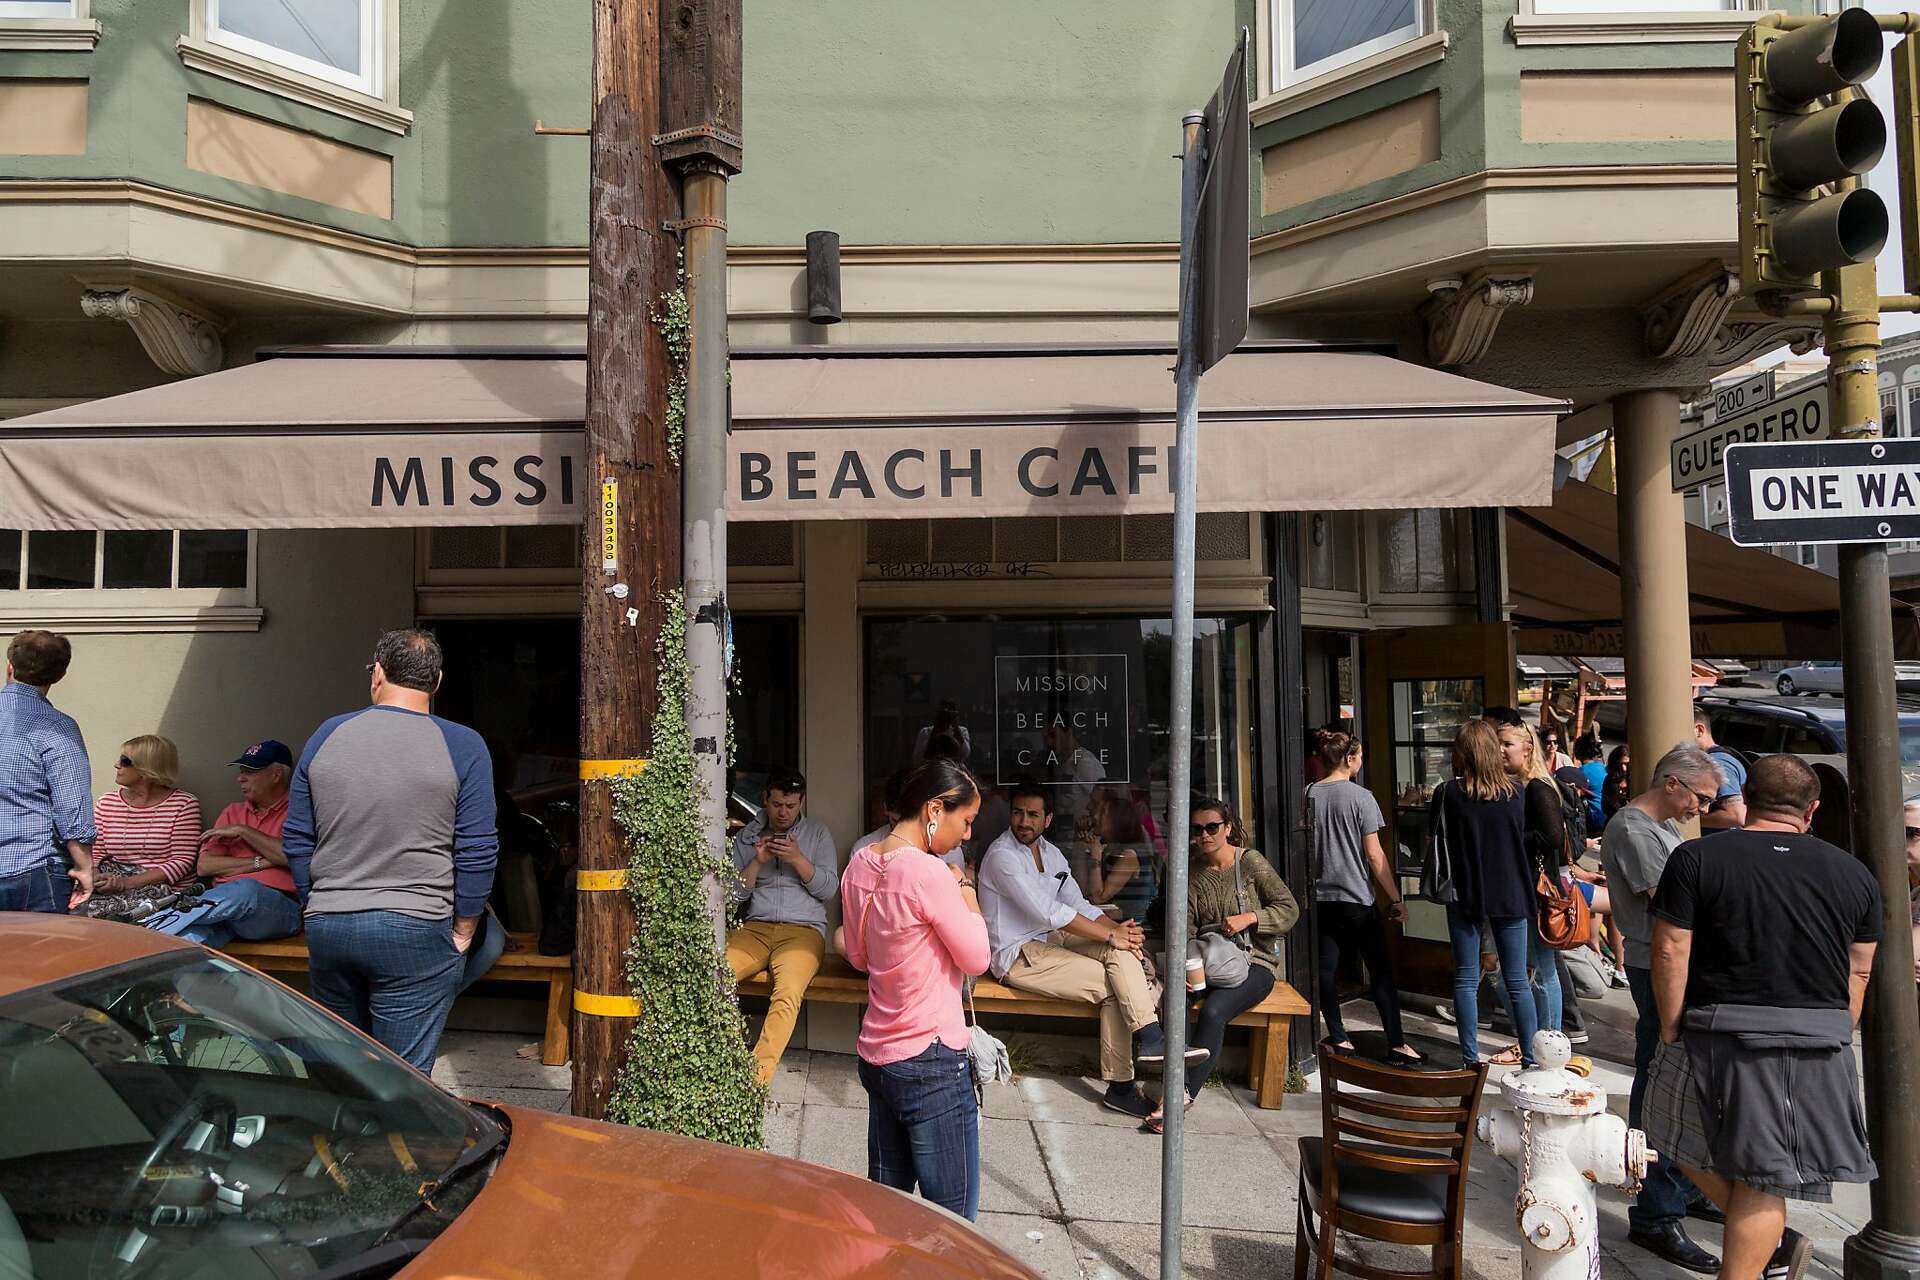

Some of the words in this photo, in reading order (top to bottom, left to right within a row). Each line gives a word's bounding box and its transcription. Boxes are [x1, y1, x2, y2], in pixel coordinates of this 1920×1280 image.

[1718, 386, 1744, 415] 200
[371, 455, 574, 507] MISSI
[739, 448, 983, 501] BEACH
[1762, 474, 1842, 512] ONE
[1016, 675, 1107, 692] MISSION
[1016, 711, 1108, 729] BEACH
[1017, 748, 1109, 766] CAFE
